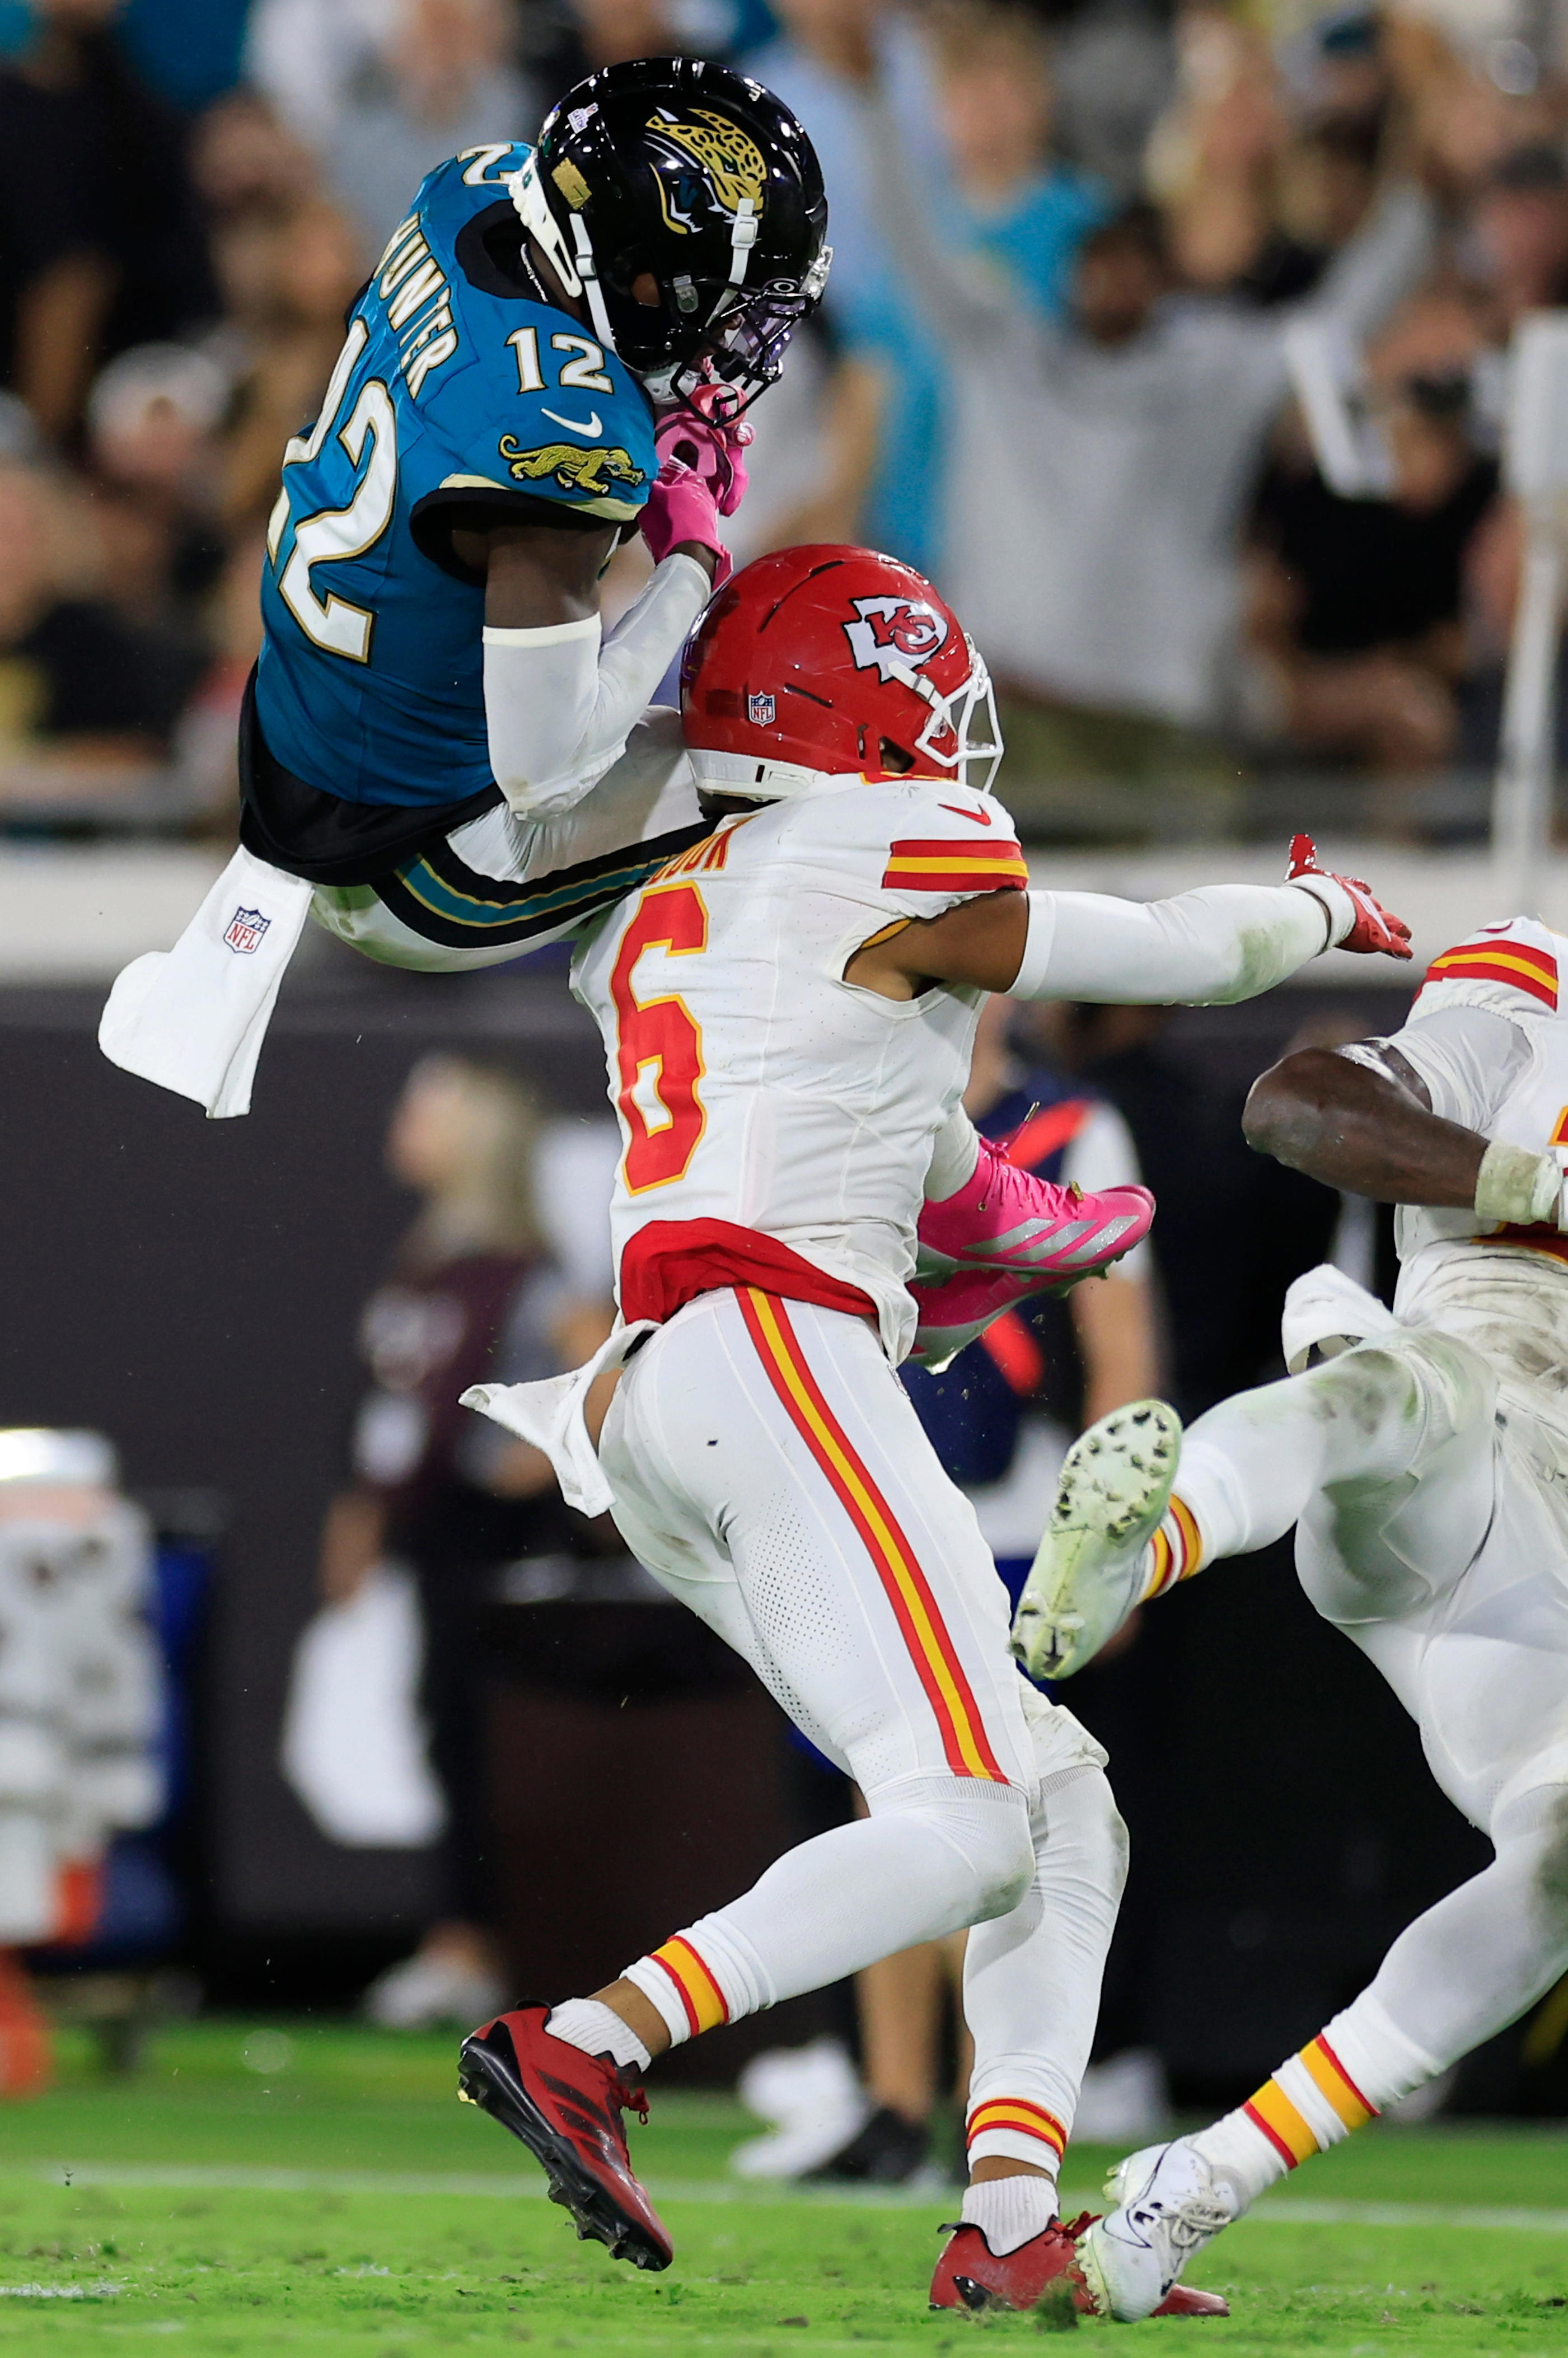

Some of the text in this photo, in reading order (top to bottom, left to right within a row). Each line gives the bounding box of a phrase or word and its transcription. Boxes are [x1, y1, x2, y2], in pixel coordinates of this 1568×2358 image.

[373, 212, 458, 400] HUNTER
[505, 327, 614, 394] 12
[865, 606, 940, 654] KC
[753, 707, 771, 720] NFL
[227, 923, 257, 950] NFL
[609, 880, 708, 1197] 6
